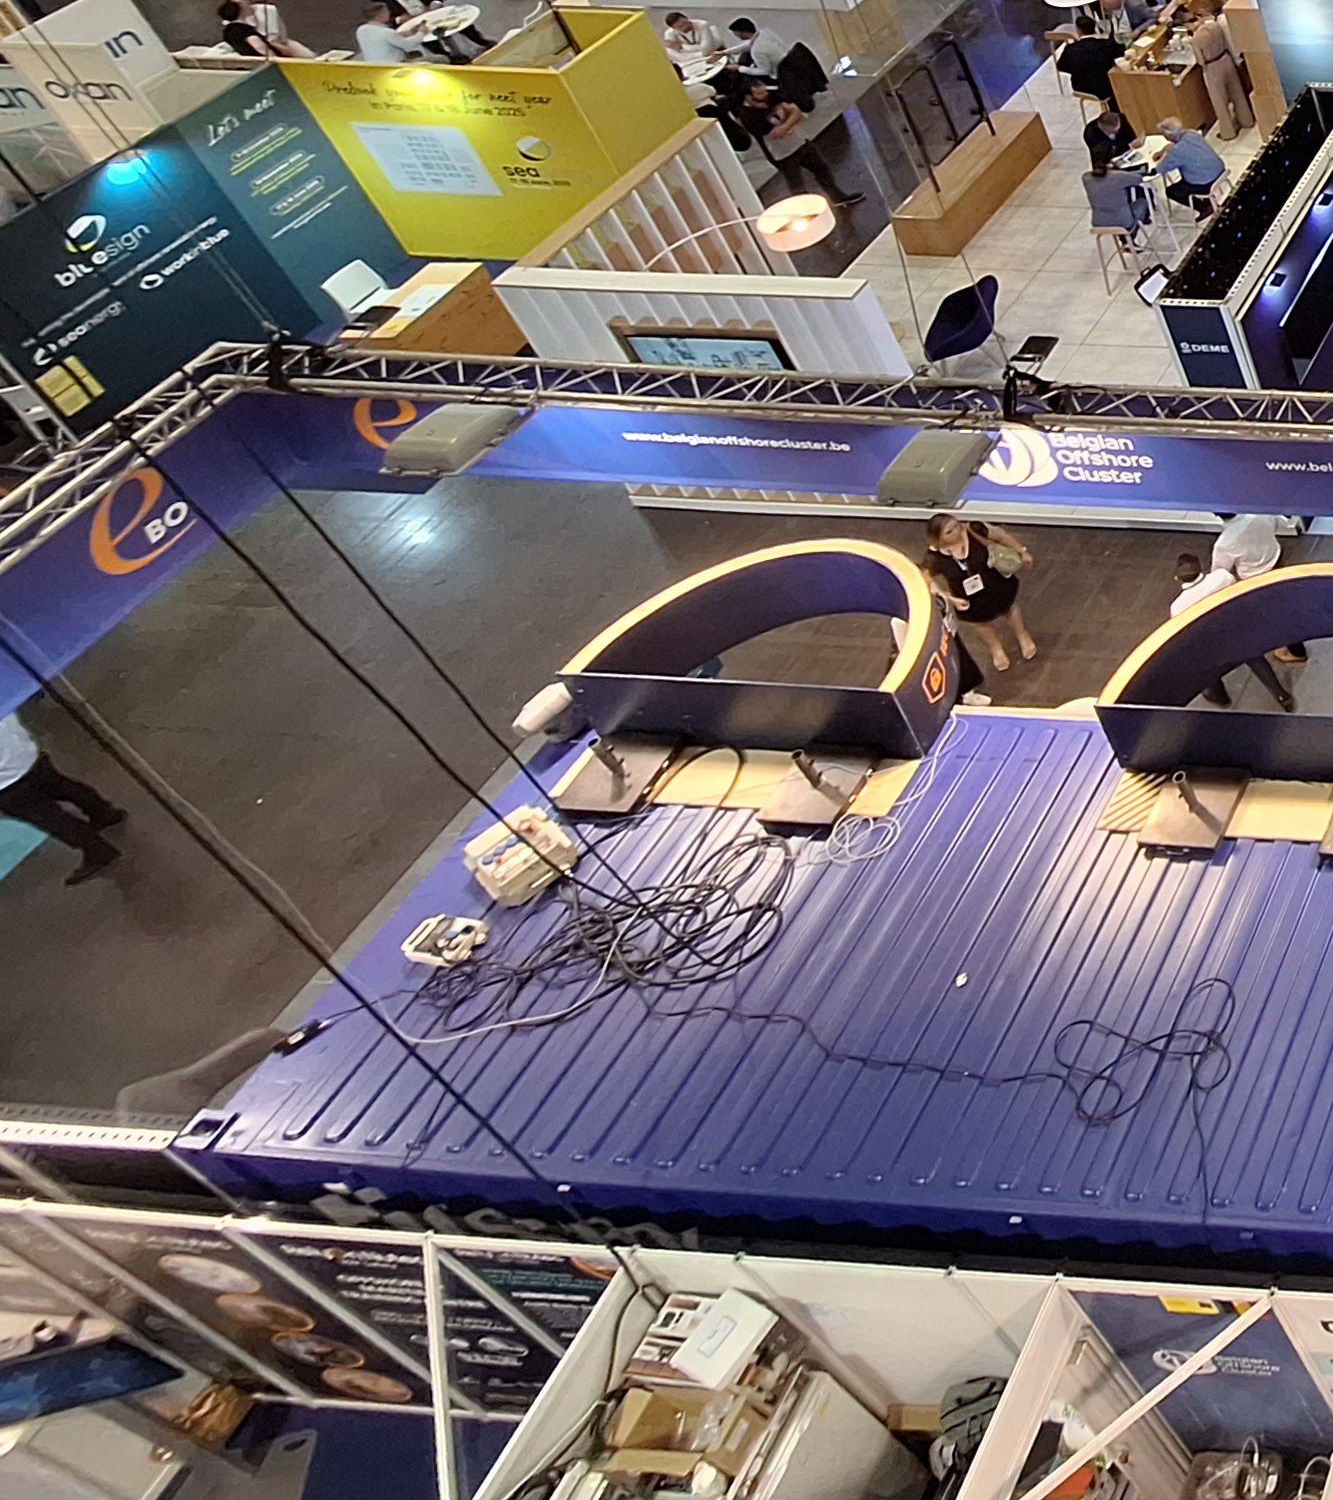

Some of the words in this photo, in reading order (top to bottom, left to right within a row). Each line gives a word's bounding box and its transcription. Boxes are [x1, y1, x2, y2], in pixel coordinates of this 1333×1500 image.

[1191, 344, 1230, 354] DEME
[1047, 431, 1134, 452] Belgian
[1055, 449, 1154, 468] Offshore
[1062, 466, 1143, 484] Cluster
